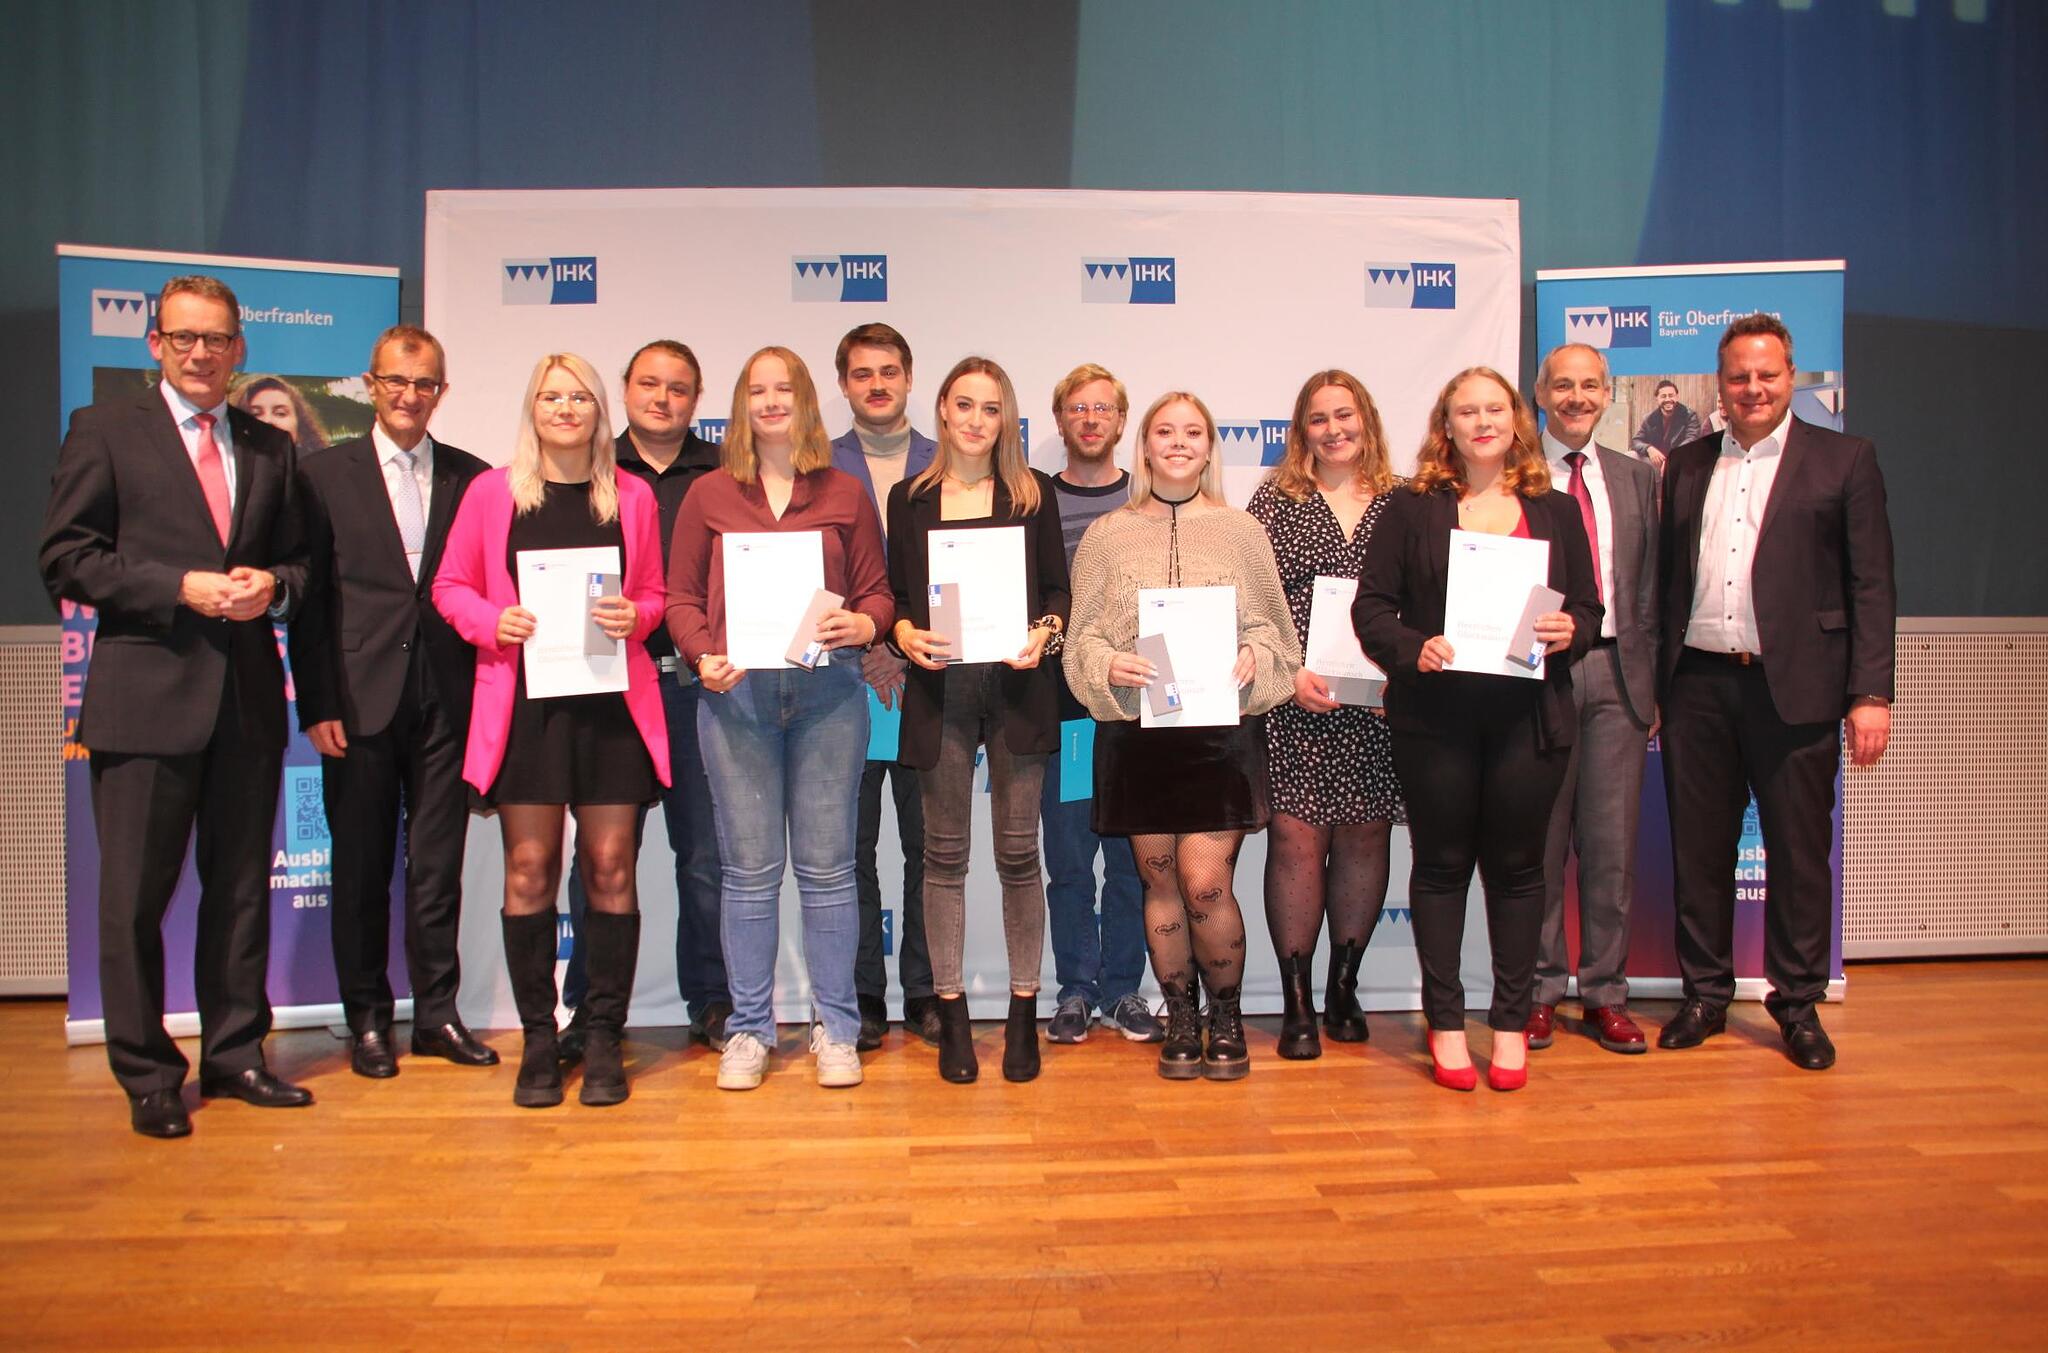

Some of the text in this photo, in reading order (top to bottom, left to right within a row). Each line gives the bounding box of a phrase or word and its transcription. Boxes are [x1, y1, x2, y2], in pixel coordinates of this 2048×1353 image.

[555, 264, 593, 282] IHK
[846, 261, 883, 279] IHK
[1134, 264, 1172, 282] IHK
[1416, 269, 1453, 287] IHK
[1614, 311, 1648, 328] IHK
[1658, 310, 1680, 326] für
[1659, 327, 1698, 337] Bayreuth
[705, 426, 726, 444] IH
[1266, 427, 1291, 444] IH
[273, 849, 331, 868] Ausbi
[270, 870, 332, 889] macht
[293, 894, 329, 909] aus
[1736, 888, 1766, 901] aus
